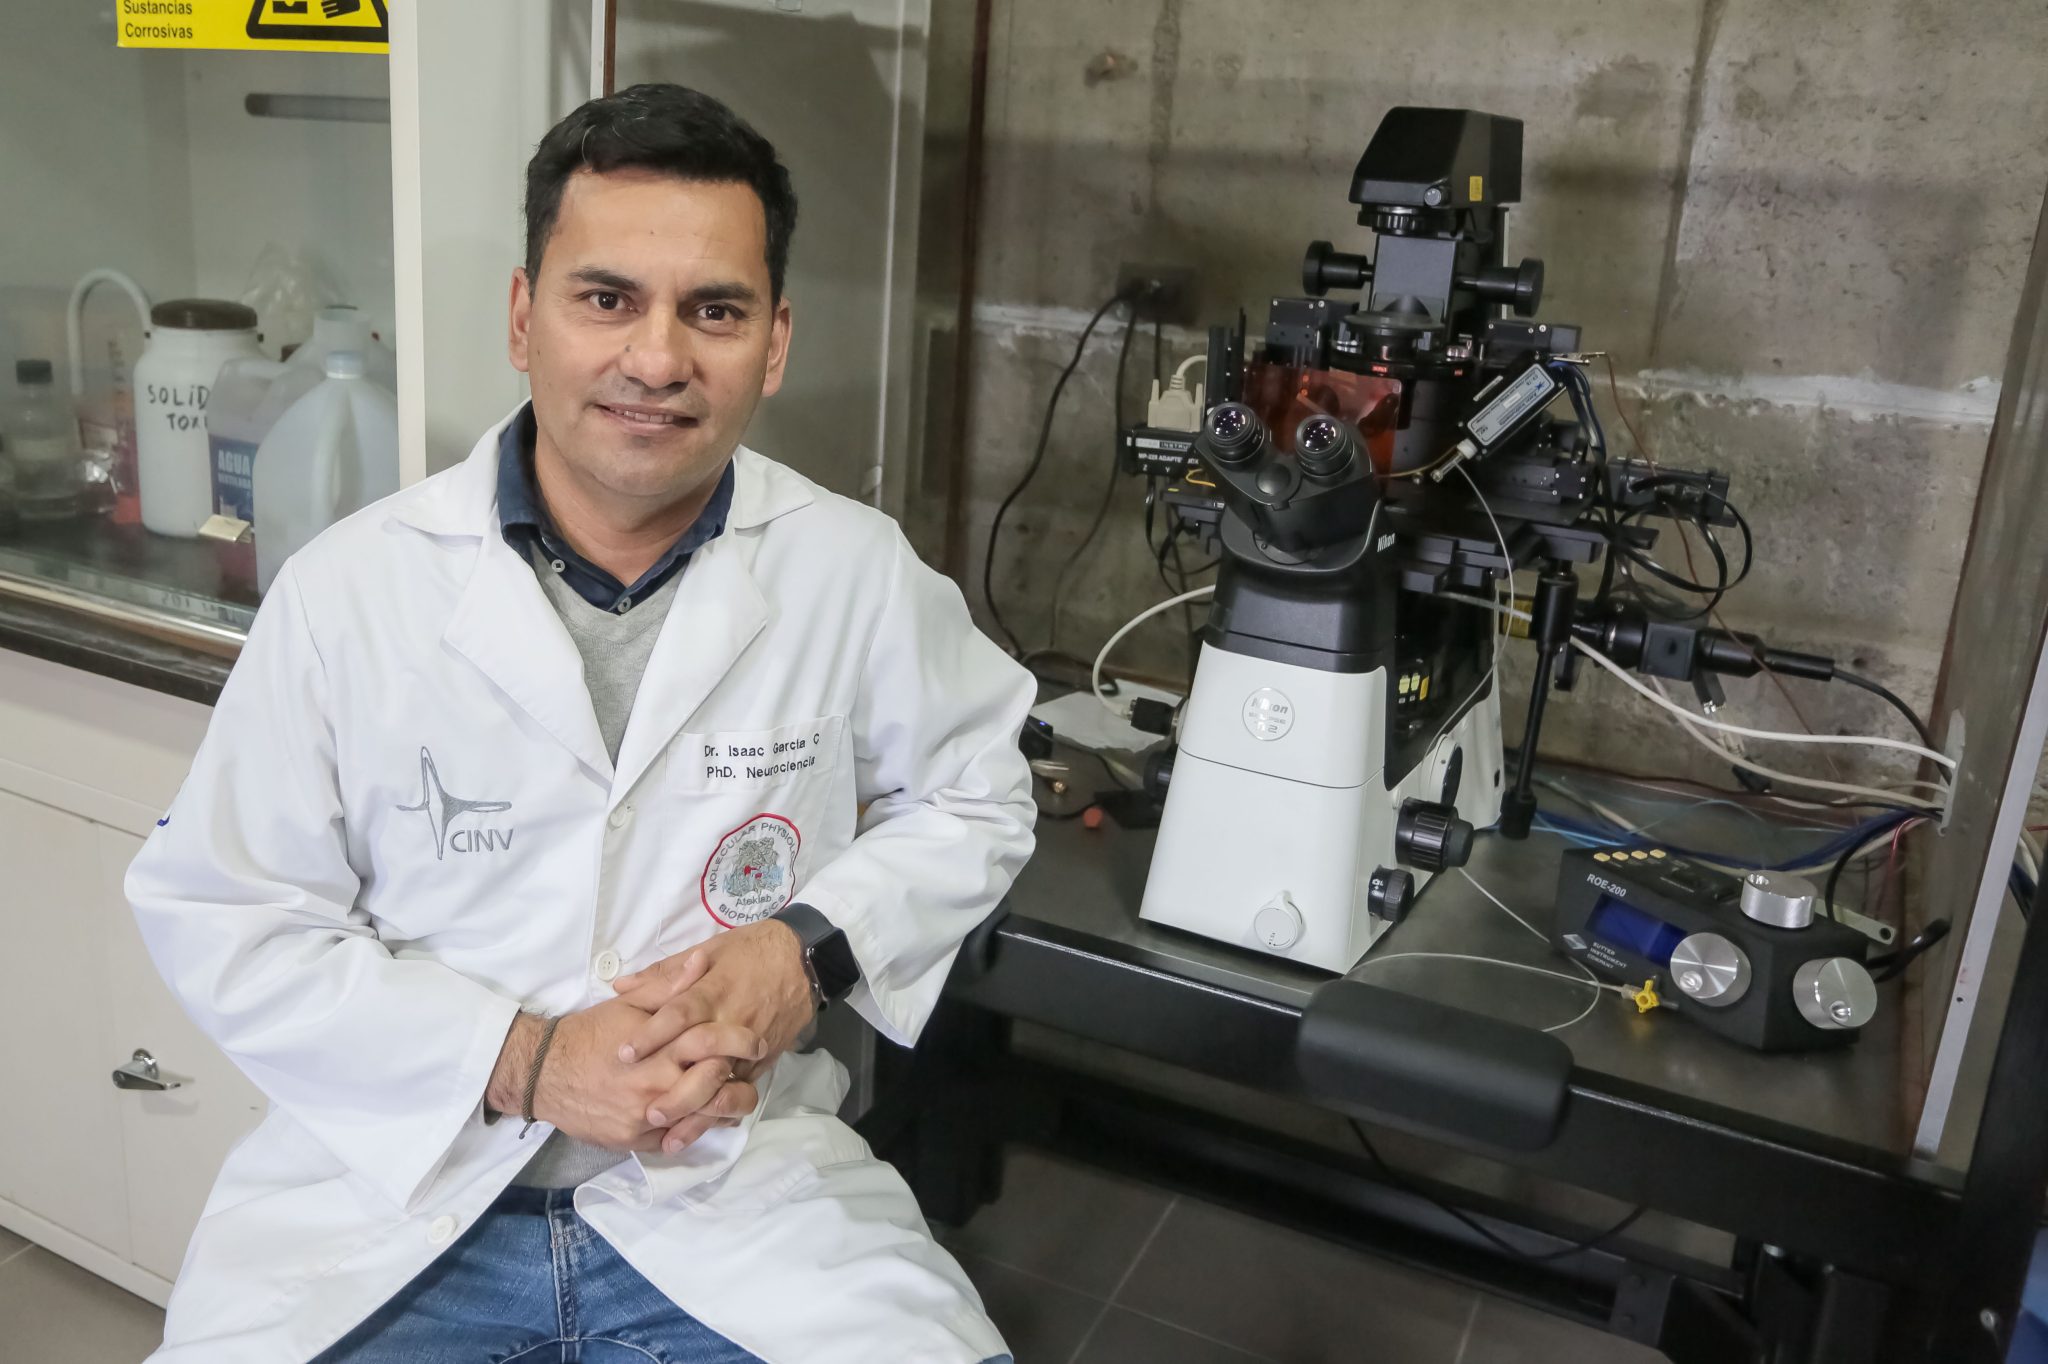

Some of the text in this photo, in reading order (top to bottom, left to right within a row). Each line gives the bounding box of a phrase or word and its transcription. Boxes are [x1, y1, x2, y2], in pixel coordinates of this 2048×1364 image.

[124, 0, 193, 15] Sustancias
[125, 22, 194, 39] Corrosivas
[218, 449, 251, 476] AGUA
[1251, 698, 1288, 714] Non
[704, 745, 719, 757] Dr.
[728, 745, 765, 757] Isaac
[813, 733, 820, 744] C
[449, 828, 514, 852] CINV
[709, 825, 756, 893] MOLECULAR
[1586, 873, 1627, 897] ROE-200
[718, 894, 786, 922] BIOPHYSICS
